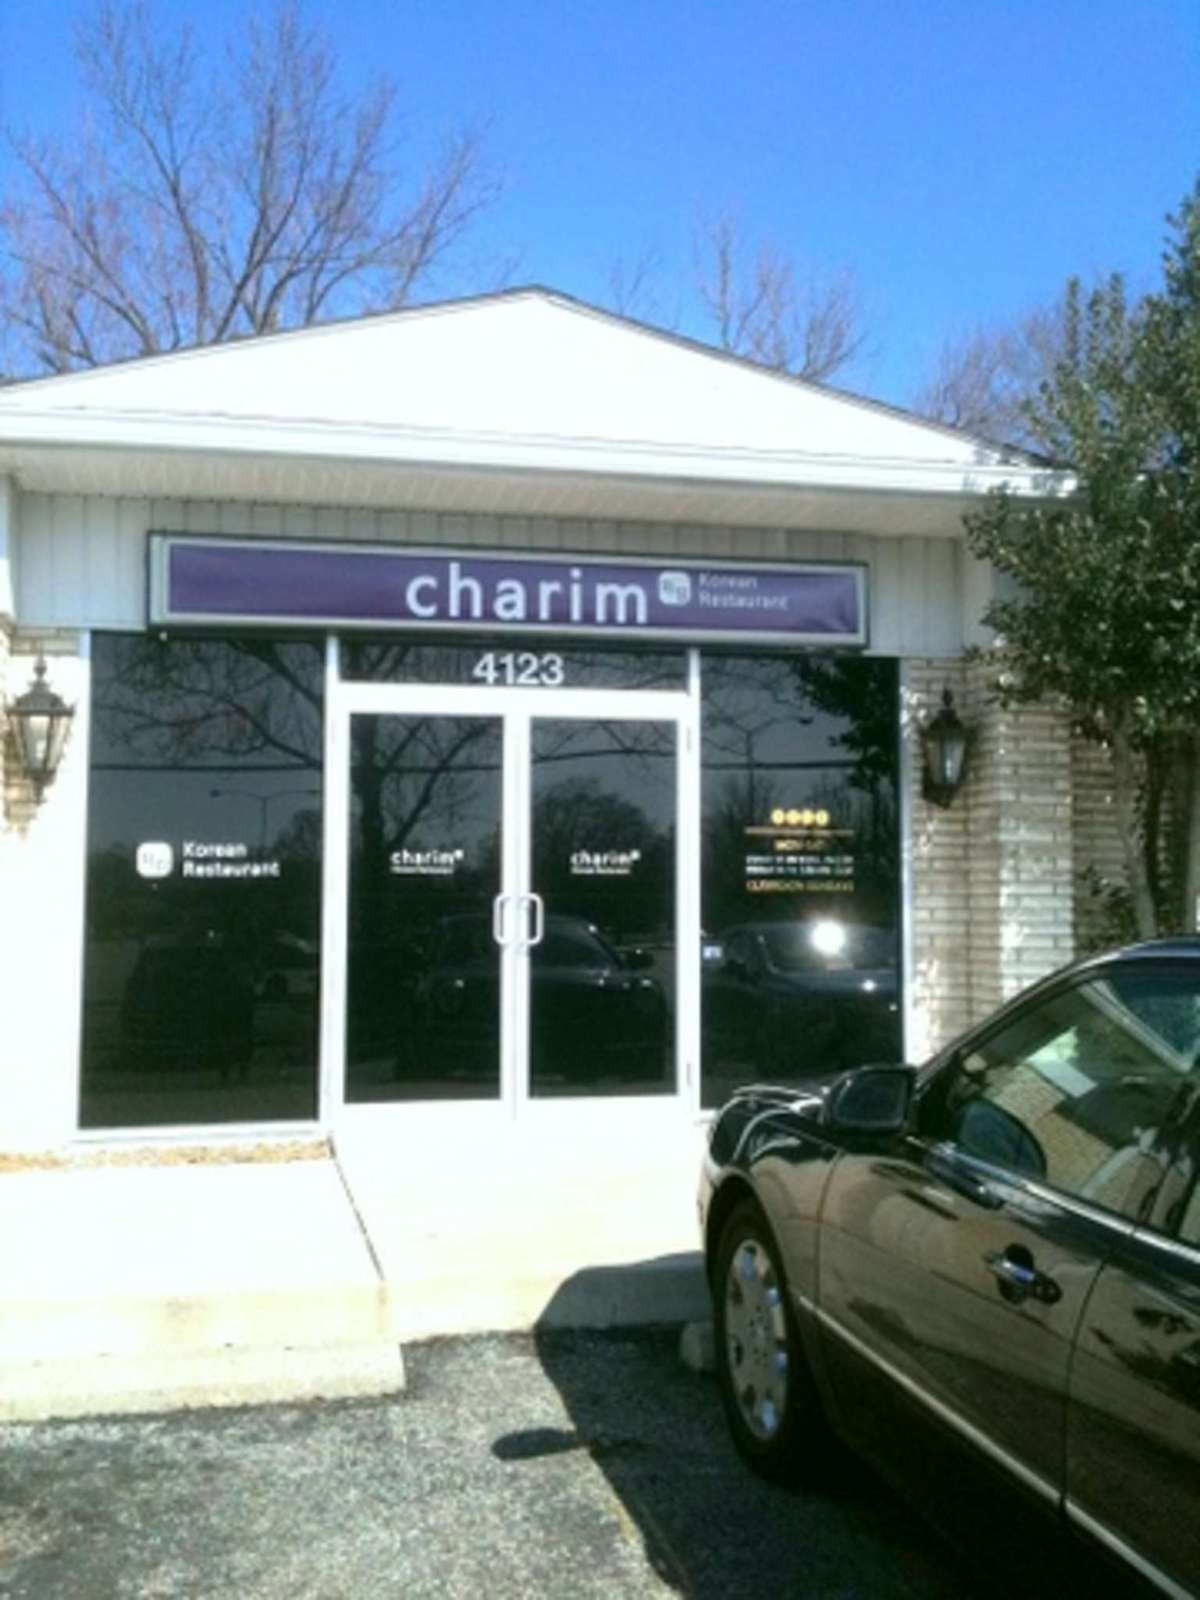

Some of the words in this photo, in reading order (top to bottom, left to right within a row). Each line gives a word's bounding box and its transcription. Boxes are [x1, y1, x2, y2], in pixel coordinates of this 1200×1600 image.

[405, 561, 648, 624] charim
[472, 653, 565, 686] 4123
[182, 841, 248, 858] Korean
[390, 848, 454, 865] charim
[182, 860, 280, 878] Restaurant
